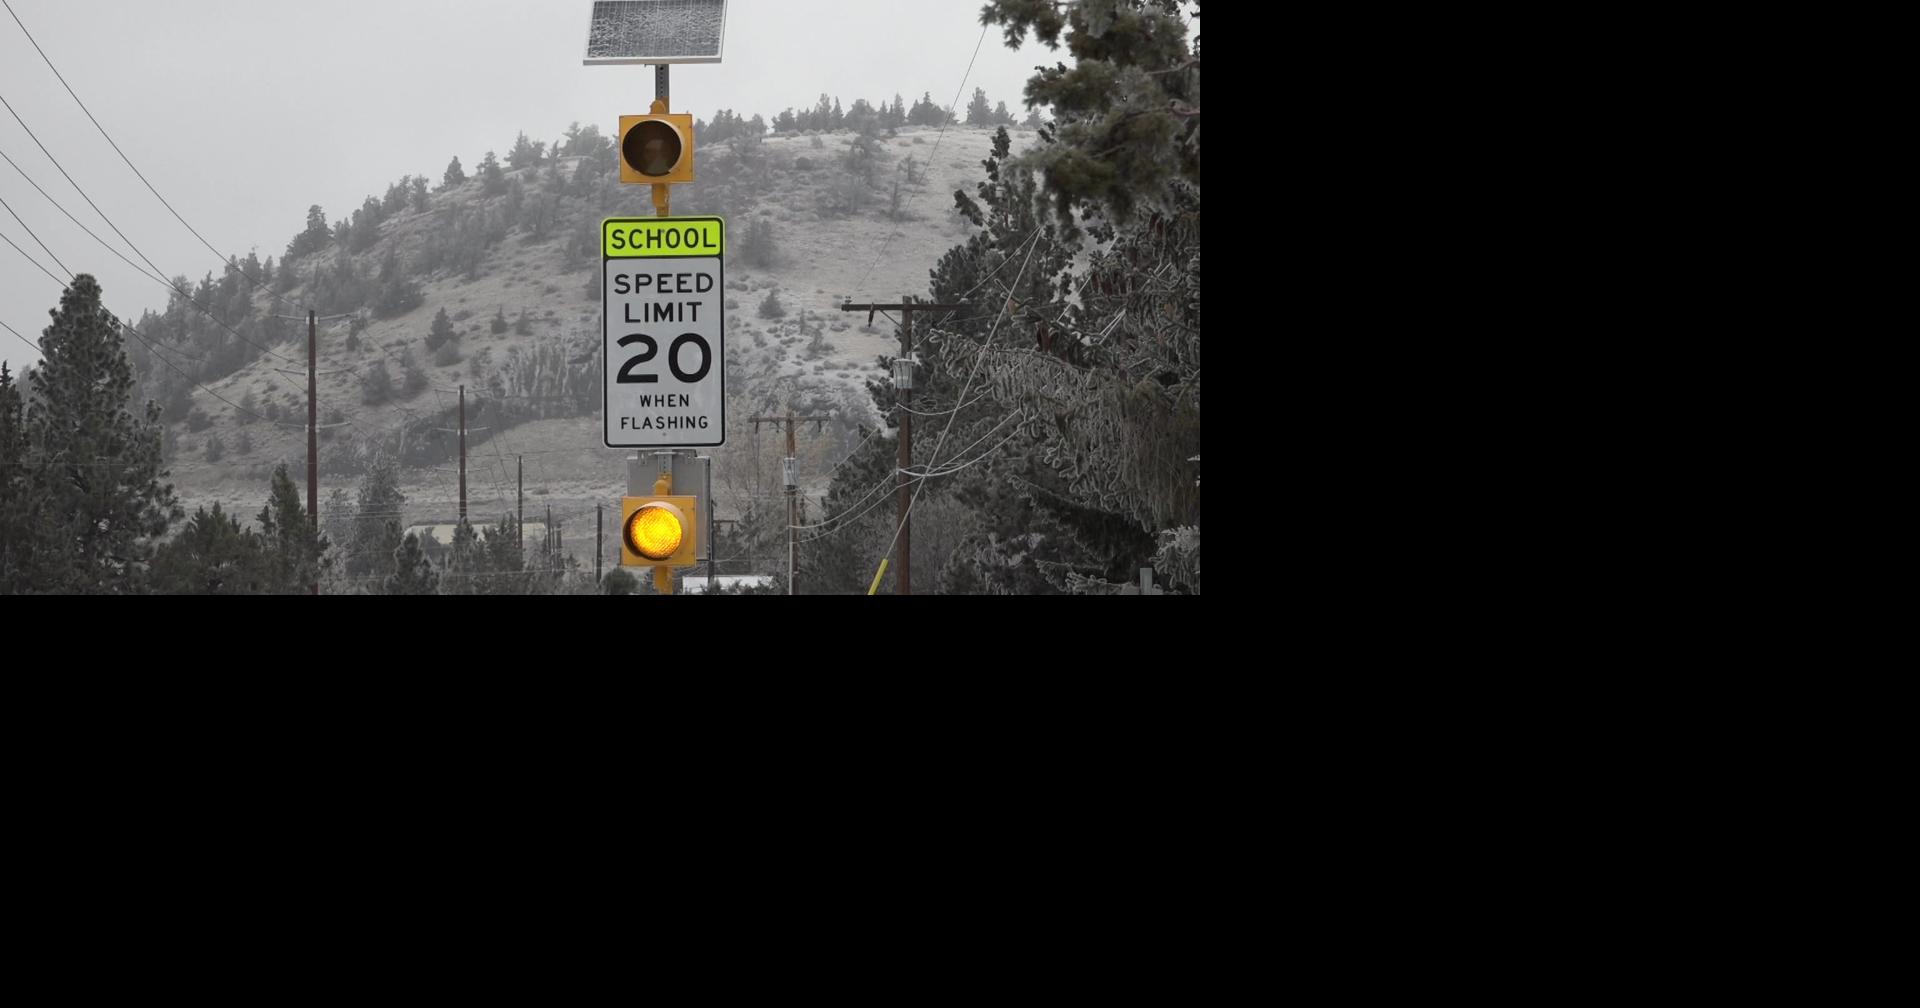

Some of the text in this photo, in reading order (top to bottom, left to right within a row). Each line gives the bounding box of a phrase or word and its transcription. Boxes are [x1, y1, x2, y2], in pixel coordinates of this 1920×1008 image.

[611, 227, 717, 250] SCHOOL
[613, 272, 714, 295] SPEED
[624, 301, 702, 323] LIMIT
[616, 332, 712, 384] 20
[639, 394, 690, 408] WHEN
[620, 416, 709, 430] FLASHING
